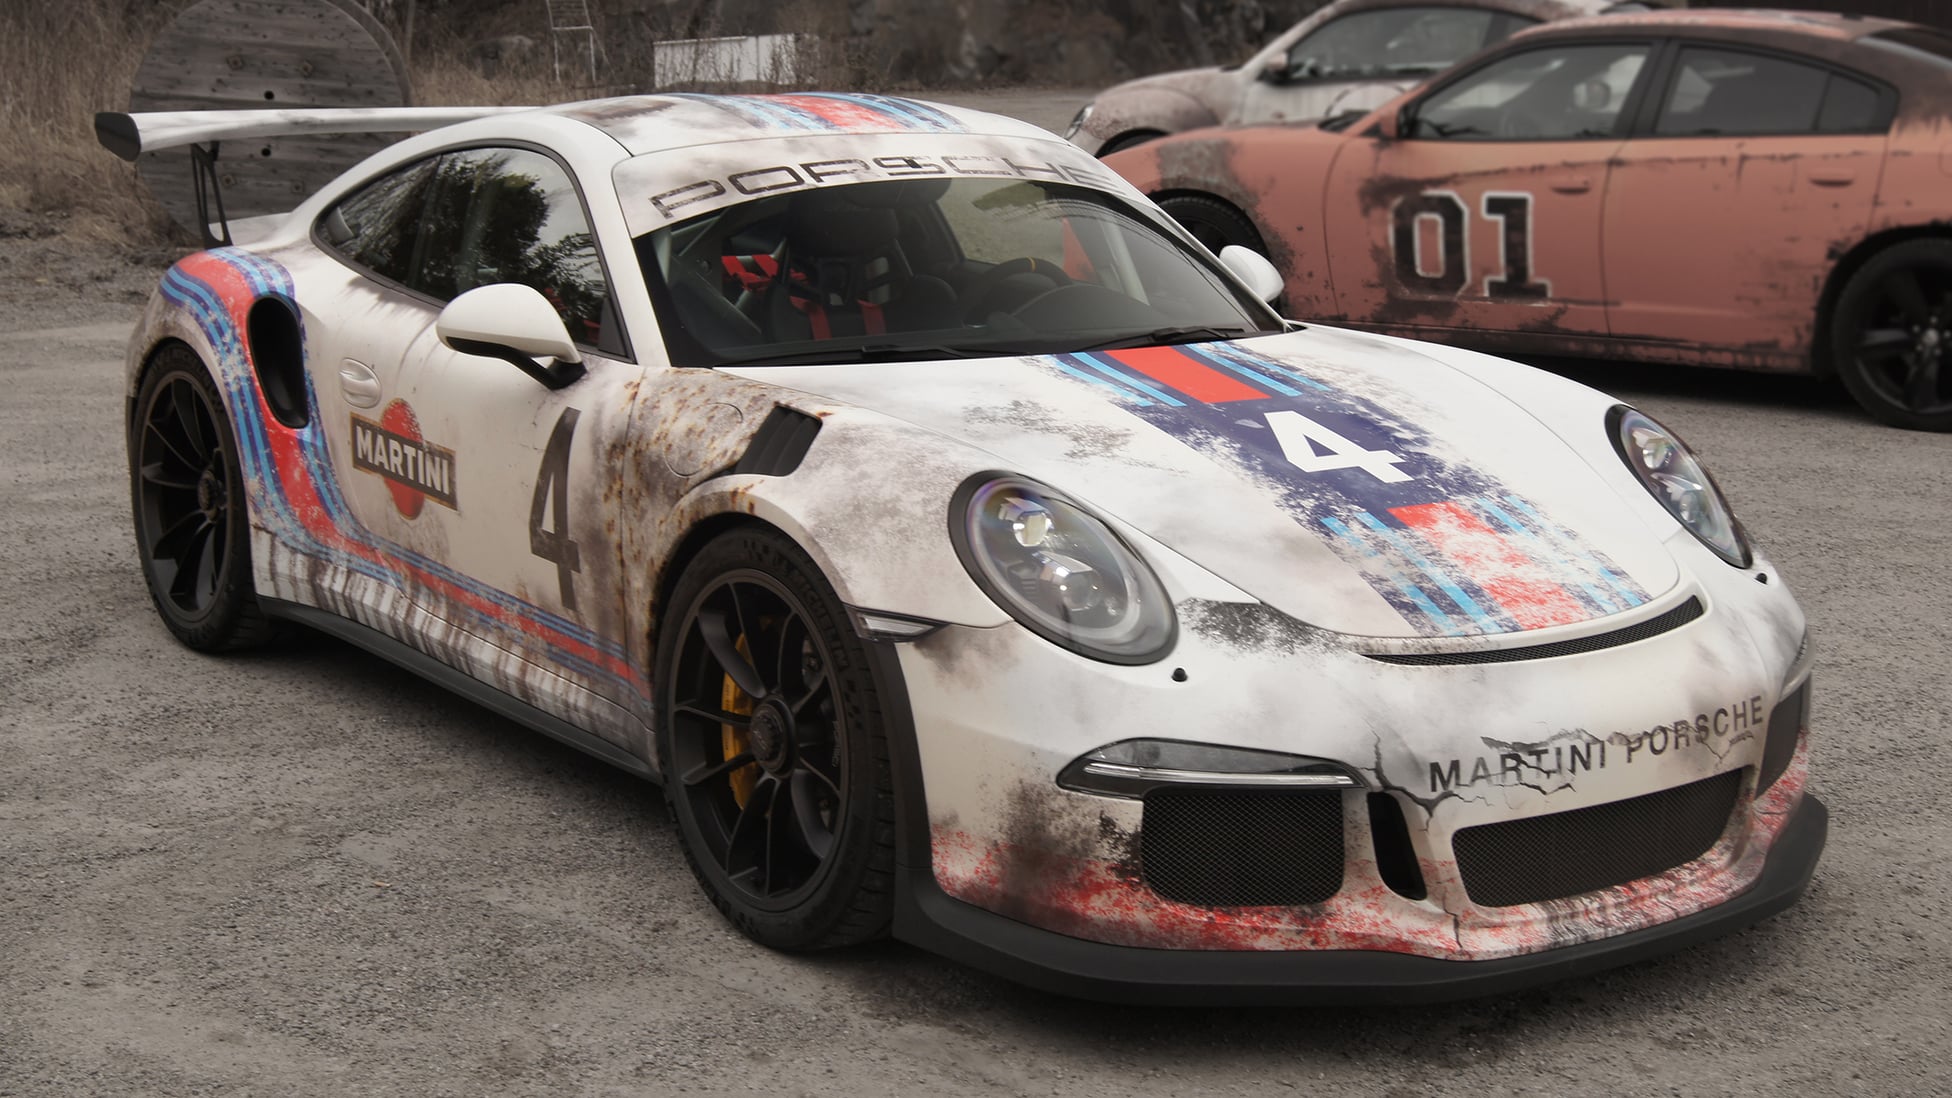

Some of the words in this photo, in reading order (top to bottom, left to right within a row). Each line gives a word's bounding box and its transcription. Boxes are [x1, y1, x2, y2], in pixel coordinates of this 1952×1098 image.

[650, 155, 1127, 219] PORSCHE
[1389, 189, 1551, 306] 01
[355, 425, 450, 496] MARTINI
[1263, 410, 1415, 484] 4
[528, 406, 582, 612] 4
[1429, 741, 1606, 793] MARTINI
[1626, 695, 1764, 764] PORSCHE
